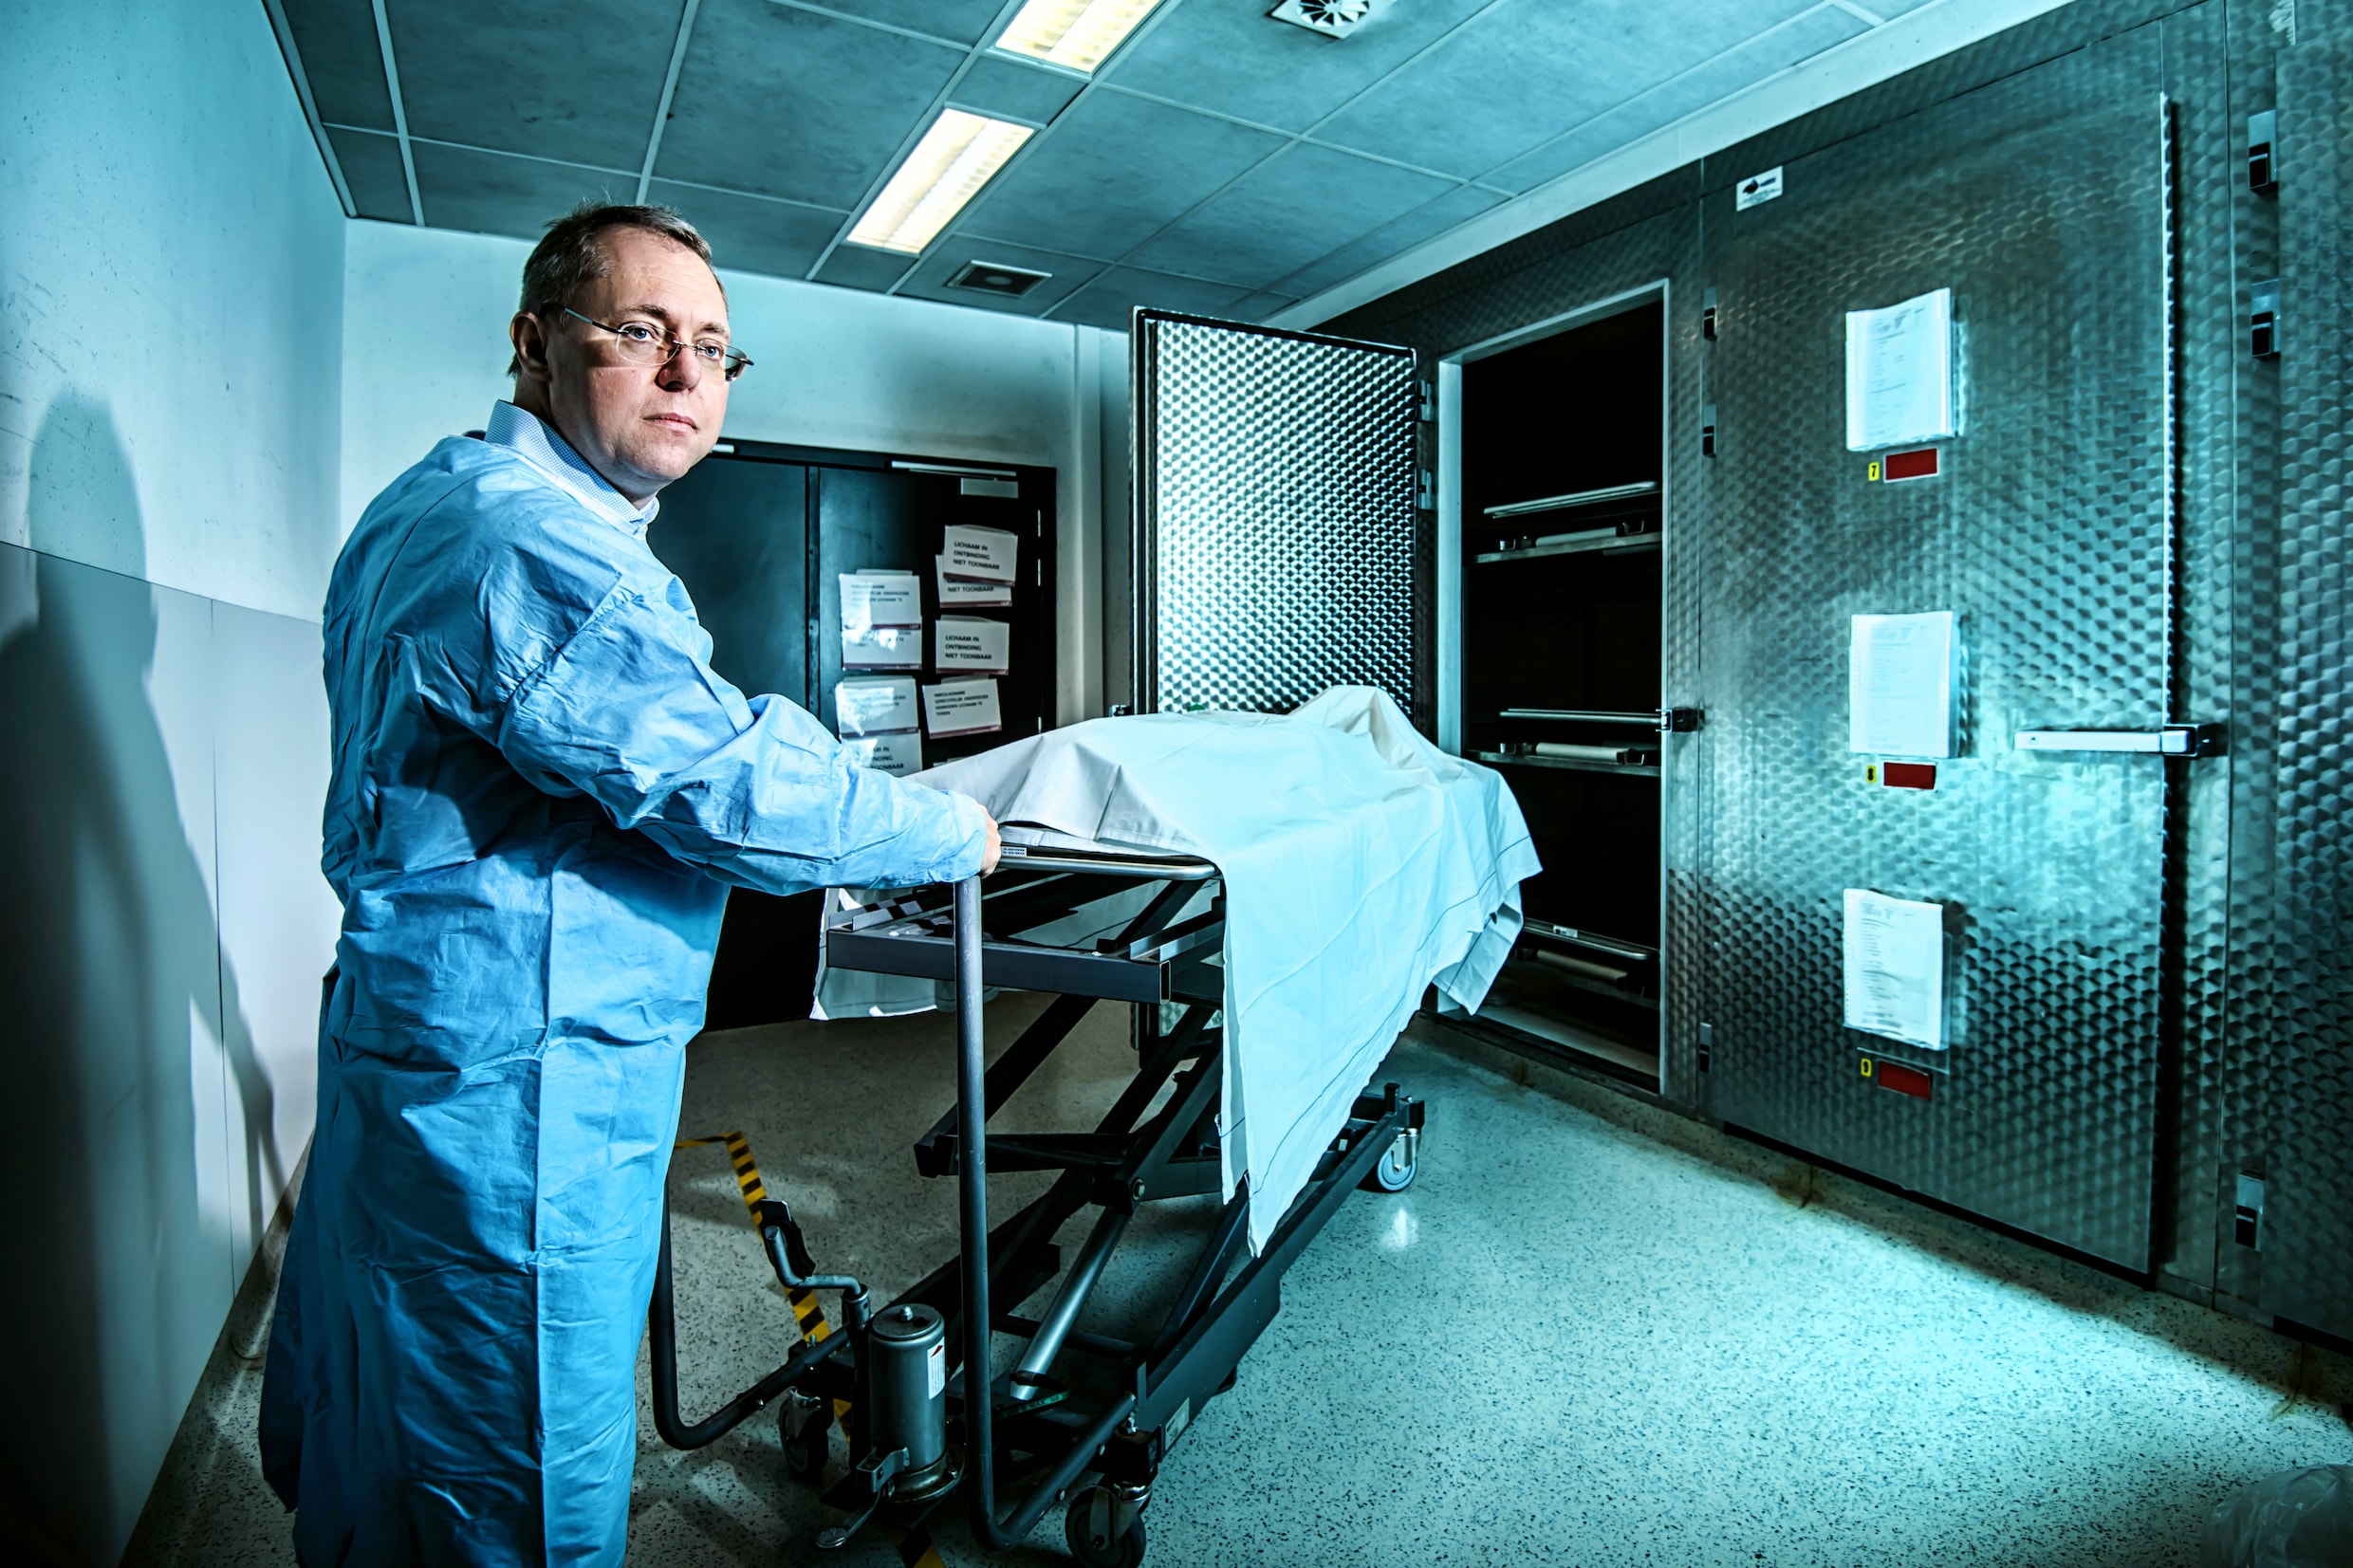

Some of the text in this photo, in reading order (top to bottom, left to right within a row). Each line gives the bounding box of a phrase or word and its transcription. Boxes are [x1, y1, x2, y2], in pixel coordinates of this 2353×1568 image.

[1871, 465, 1878, 477] 7
[954, 550, 990, 560] ONTBINDING
[968, 561, 1000, 569] TOONBAAR
[1867, 767, 1874, 781] 8
